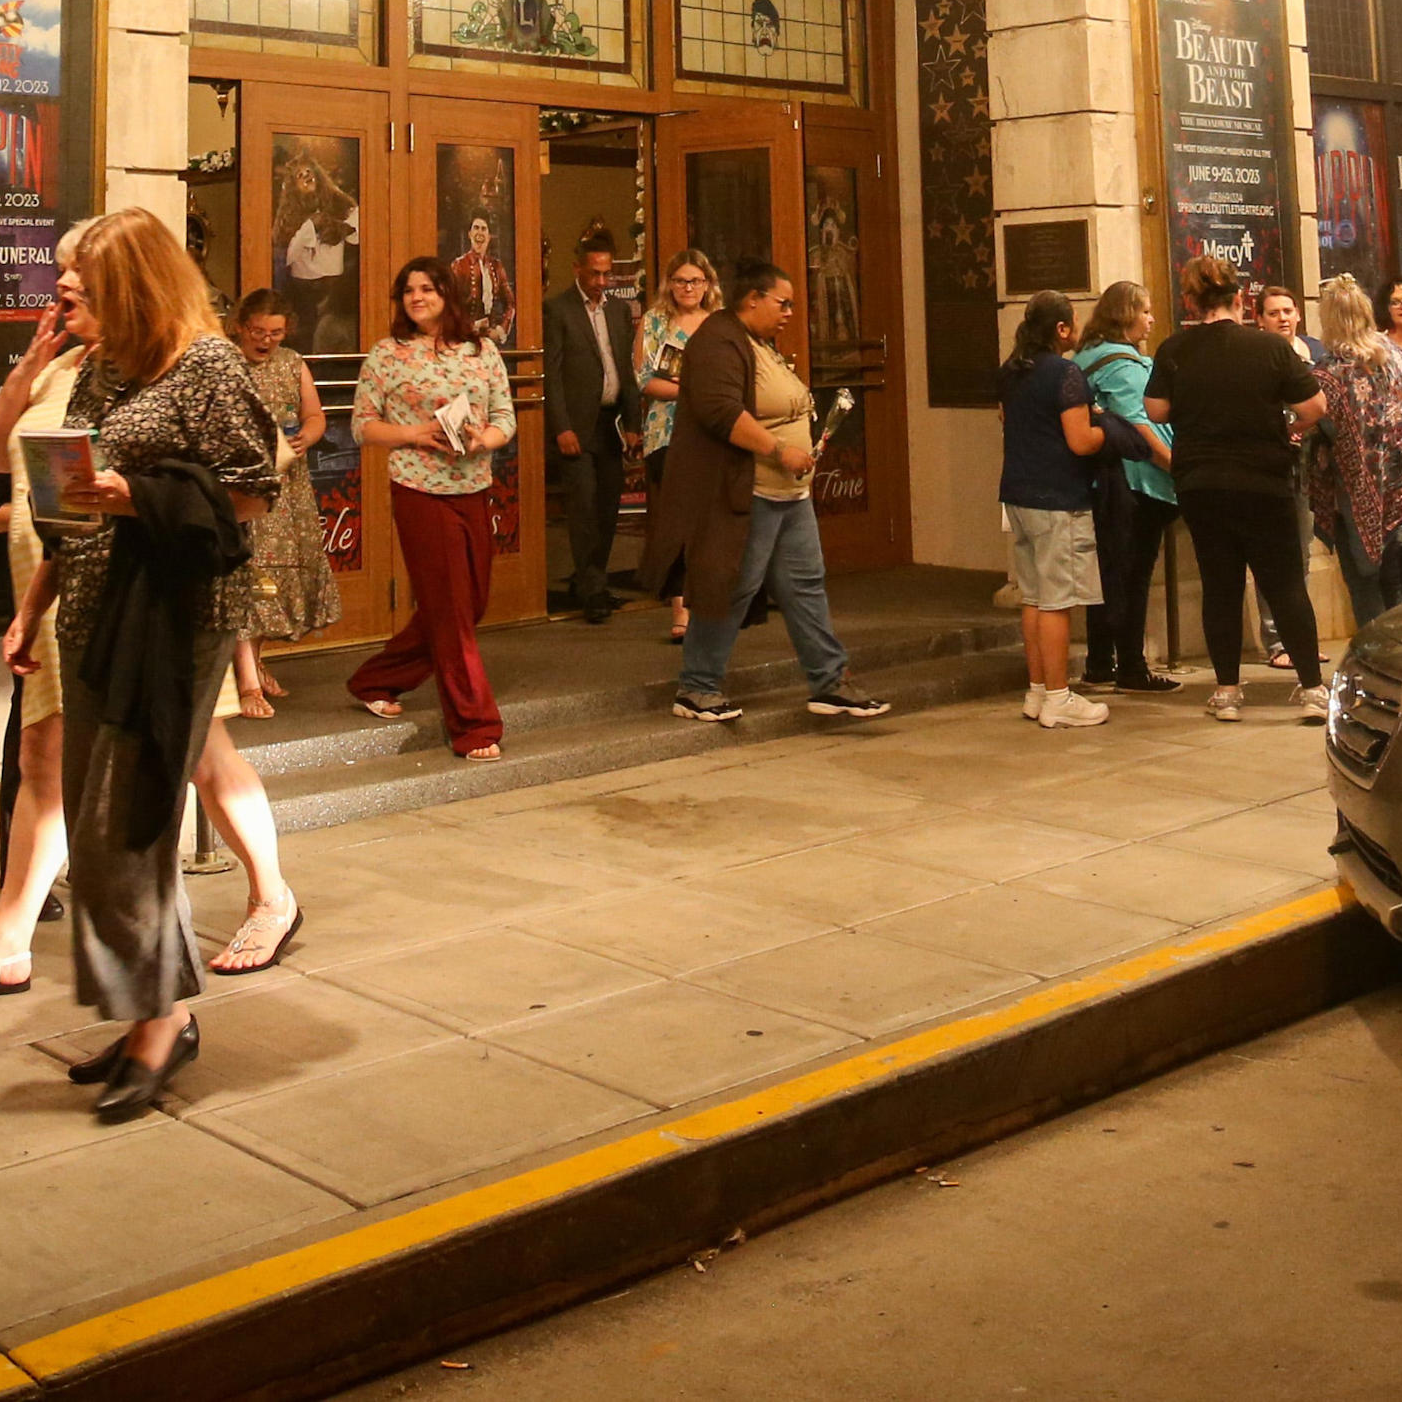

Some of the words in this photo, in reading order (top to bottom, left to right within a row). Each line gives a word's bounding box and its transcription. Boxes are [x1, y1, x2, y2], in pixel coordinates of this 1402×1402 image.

[1174, 19, 1258, 68] BEAUTY
[1206, 65, 1227, 77] AND
[1228, 67, 1248, 79] THE
[14, 79, 50, 95] 2023
[1186, 63, 1254, 109] BEAST
[1188, 165, 1211, 183] JUNE
[1235, 168, 1260, 185] 2023
[4, 193, 40, 208] 2023
[35, 218, 55, 227] EVENT
[1203, 239, 1244, 268] Mercy
[19, 293, 53, 308] 2022
[815, 468, 864, 500] Time
